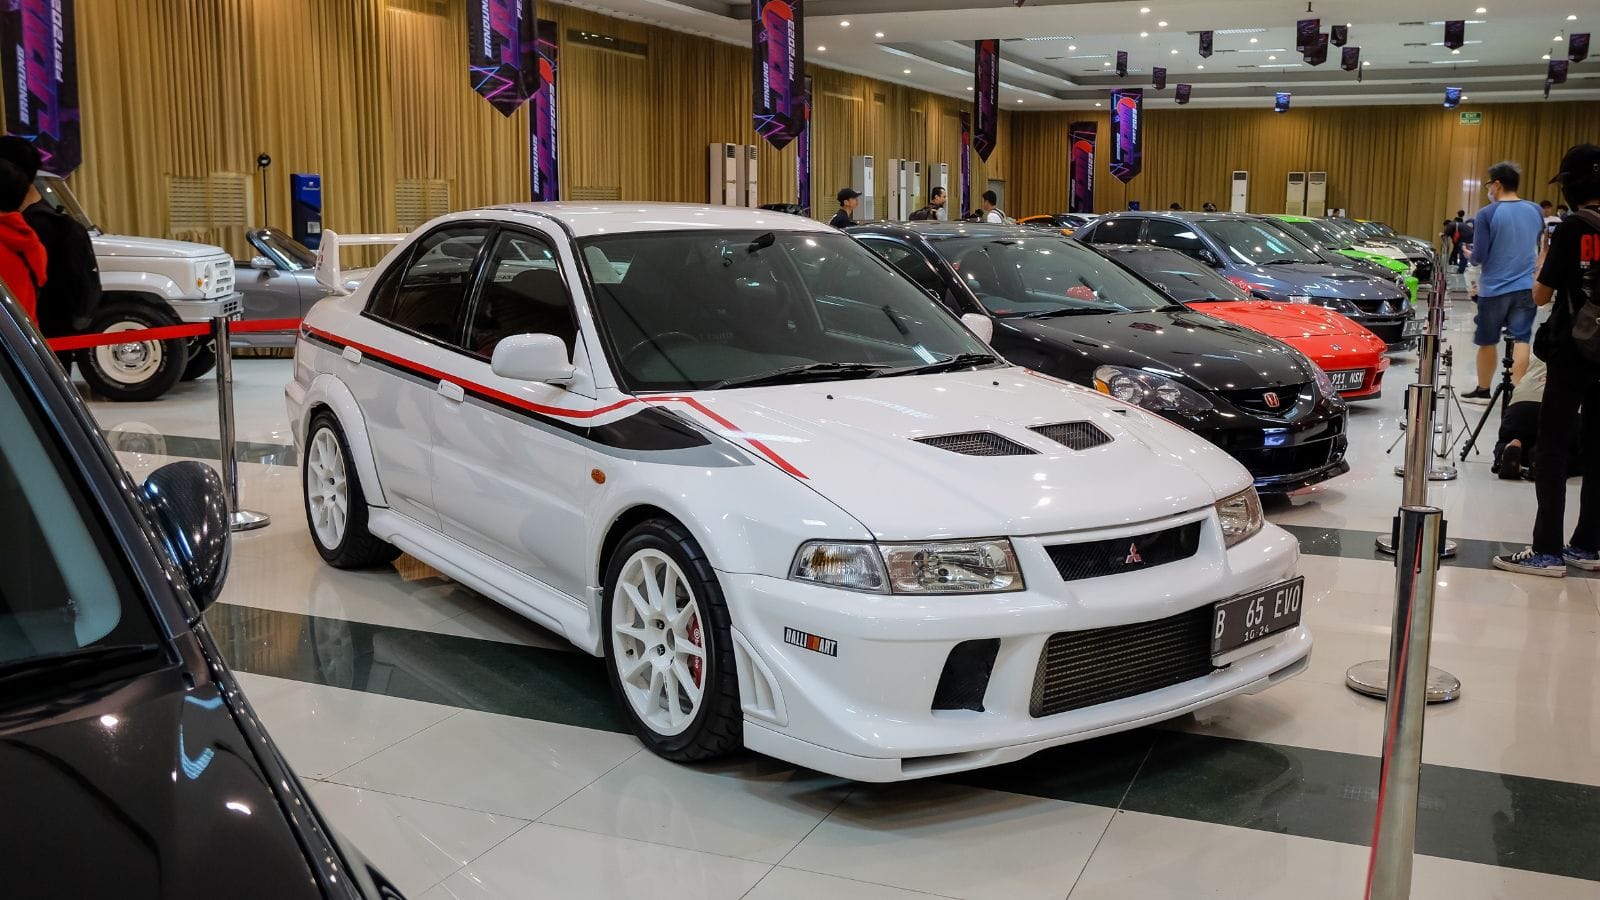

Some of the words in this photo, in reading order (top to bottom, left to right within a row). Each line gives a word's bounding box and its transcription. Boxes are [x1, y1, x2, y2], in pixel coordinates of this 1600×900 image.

[16, 44, 30, 125] BANDUNG
[532, 134, 540, 194] BANDUNG
[1350, 372, 1364, 383] NSX
[1214, 609, 1226, 639] B
[1246, 597, 1265, 628] 65
[1274, 585, 1300, 618] EVO
